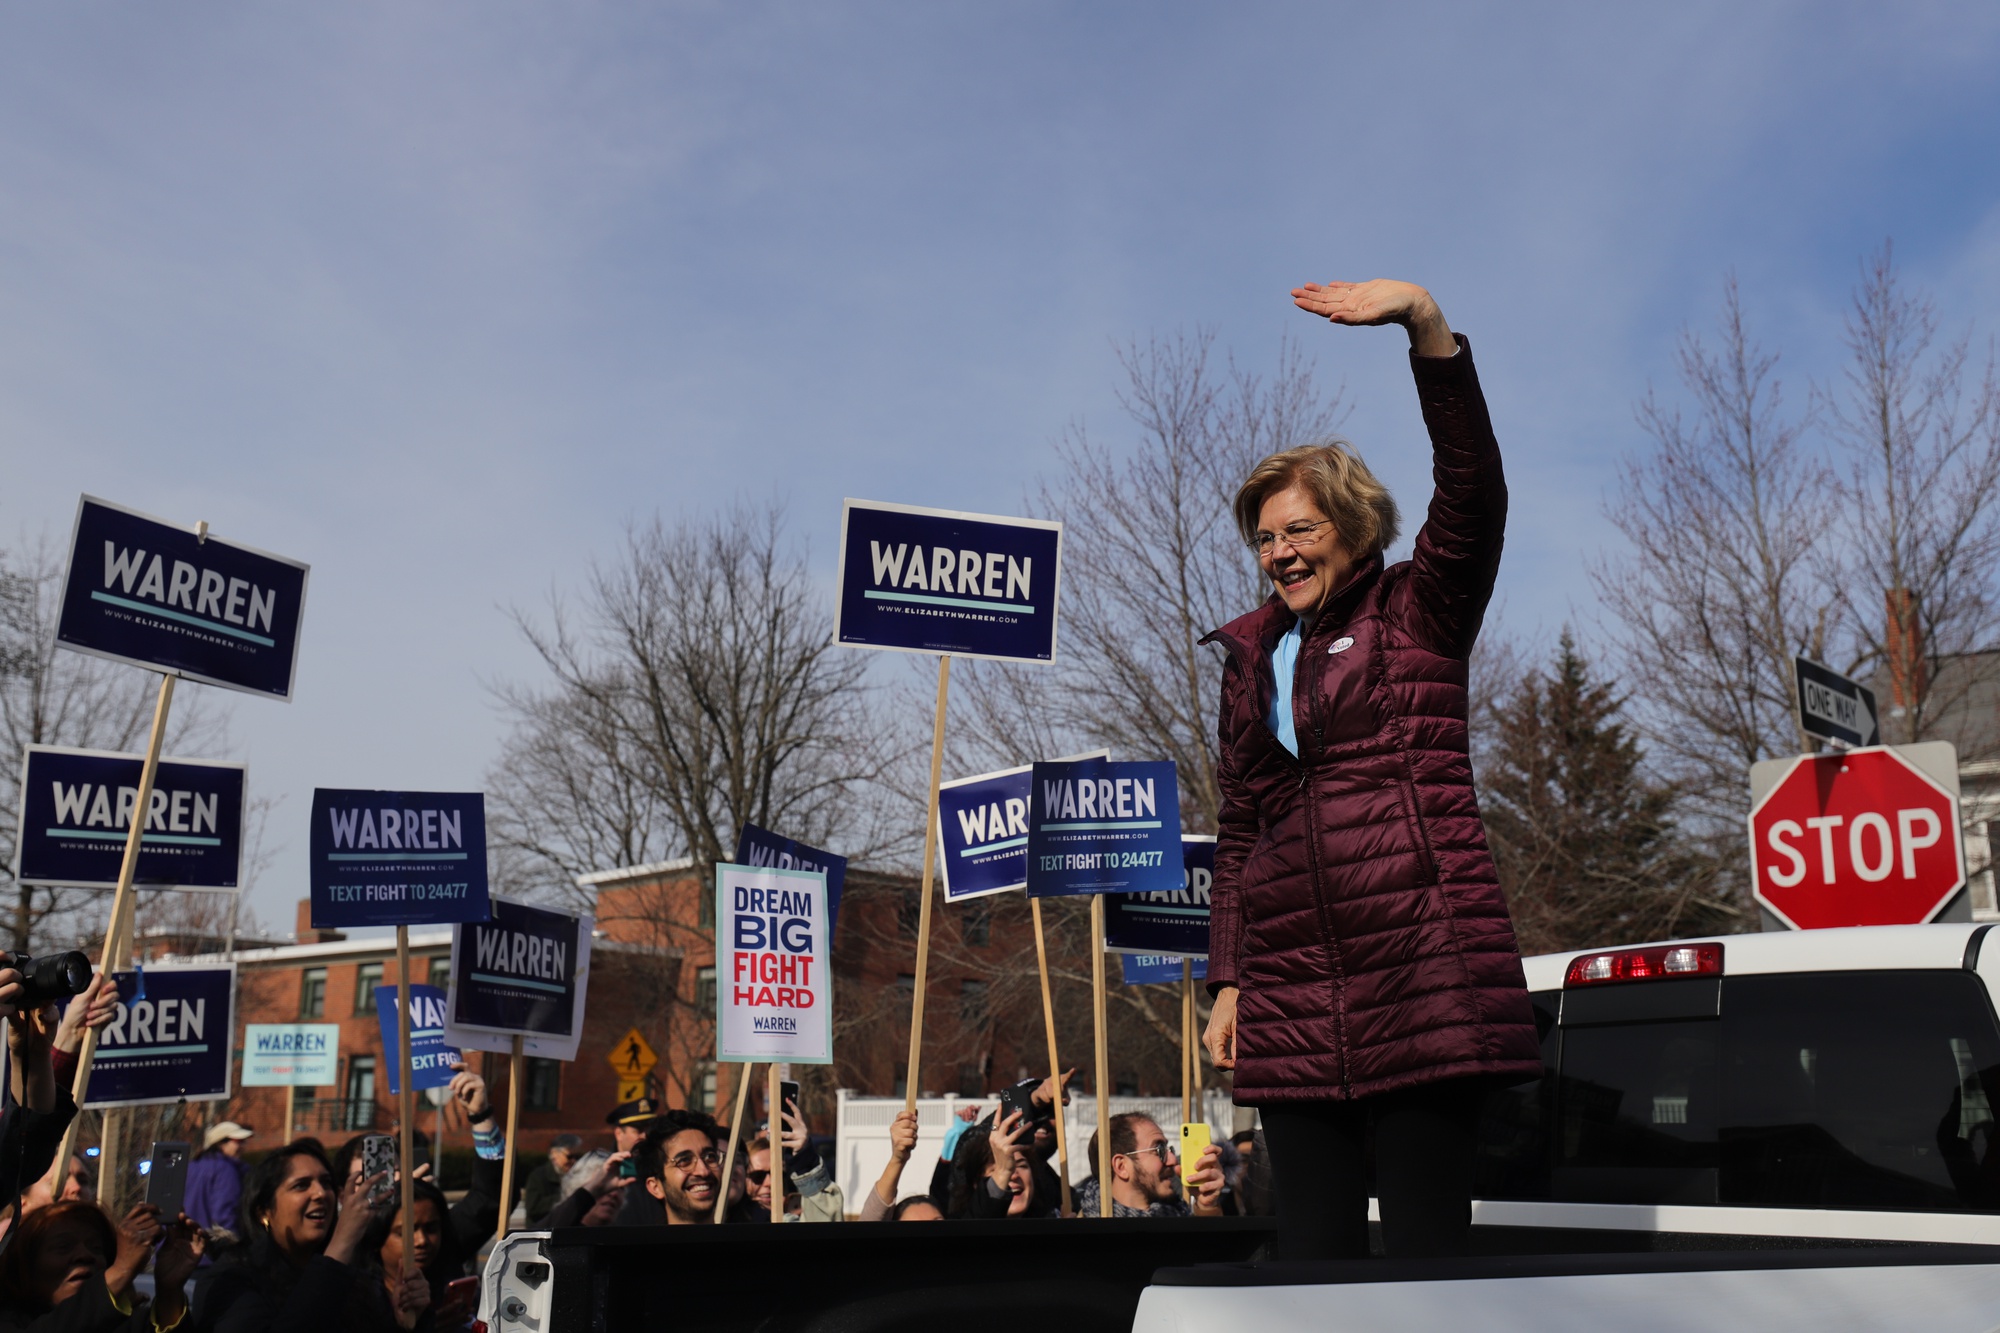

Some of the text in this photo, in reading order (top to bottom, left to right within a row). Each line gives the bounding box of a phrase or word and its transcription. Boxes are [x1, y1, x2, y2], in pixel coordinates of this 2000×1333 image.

[869, 540, 1032, 601] WARREN
[104, 540, 276, 633] WARREN
[877, 604, 1018, 624] WWW.ELIZABETHWARREN.COM
[104, 608, 257, 654] WWW.ELIZABETHWARREN.COM
[1808, 683, 1857, 728] ONE WAY
[52, 780, 219, 834] WARREN
[1044, 778, 1156, 819] WARREN
[329, 807, 462, 849] WARREN
[957, 795, 1030, 845] WAR
[59, 841, 204, 856] WWW.ELIZABWARREN.COM
[1048, 833, 1149, 842] WWW.ELIZABETHWARREN.COM
[1767, 807, 1942, 888] STOP
[339, 865, 455, 873] WWW.ELIZABETHWARREN.COM
[972, 848, 1028, 865] WWW.ELIZABET
[1040, 851, 1163, 871] TEXT FIGHT TO 24477
[329, 883, 468, 901] TEXT FIGHT TO 24477
[734, 886, 812, 917] DREAM
[734, 914, 812, 953] BIG
[1132, 915, 1210, 926] WWW.ELIZABETHWA
[476, 925, 566, 982] WARREN
[1135, 955, 1160, 967] TEXT
[1162, 955, 1184, 965] FIGH
[734, 952, 814, 986] FIGHT
[734, 985, 814, 1009] HARD
[96, 999, 205, 1046] RREN
[754, 1016, 796, 1031] WARREN
[257, 1033, 326, 1051] WARREN
[91, 1058, 191, 1071] ZABETHWARREN.COM
[411, 1051, 461, 1070] EXT FIG
